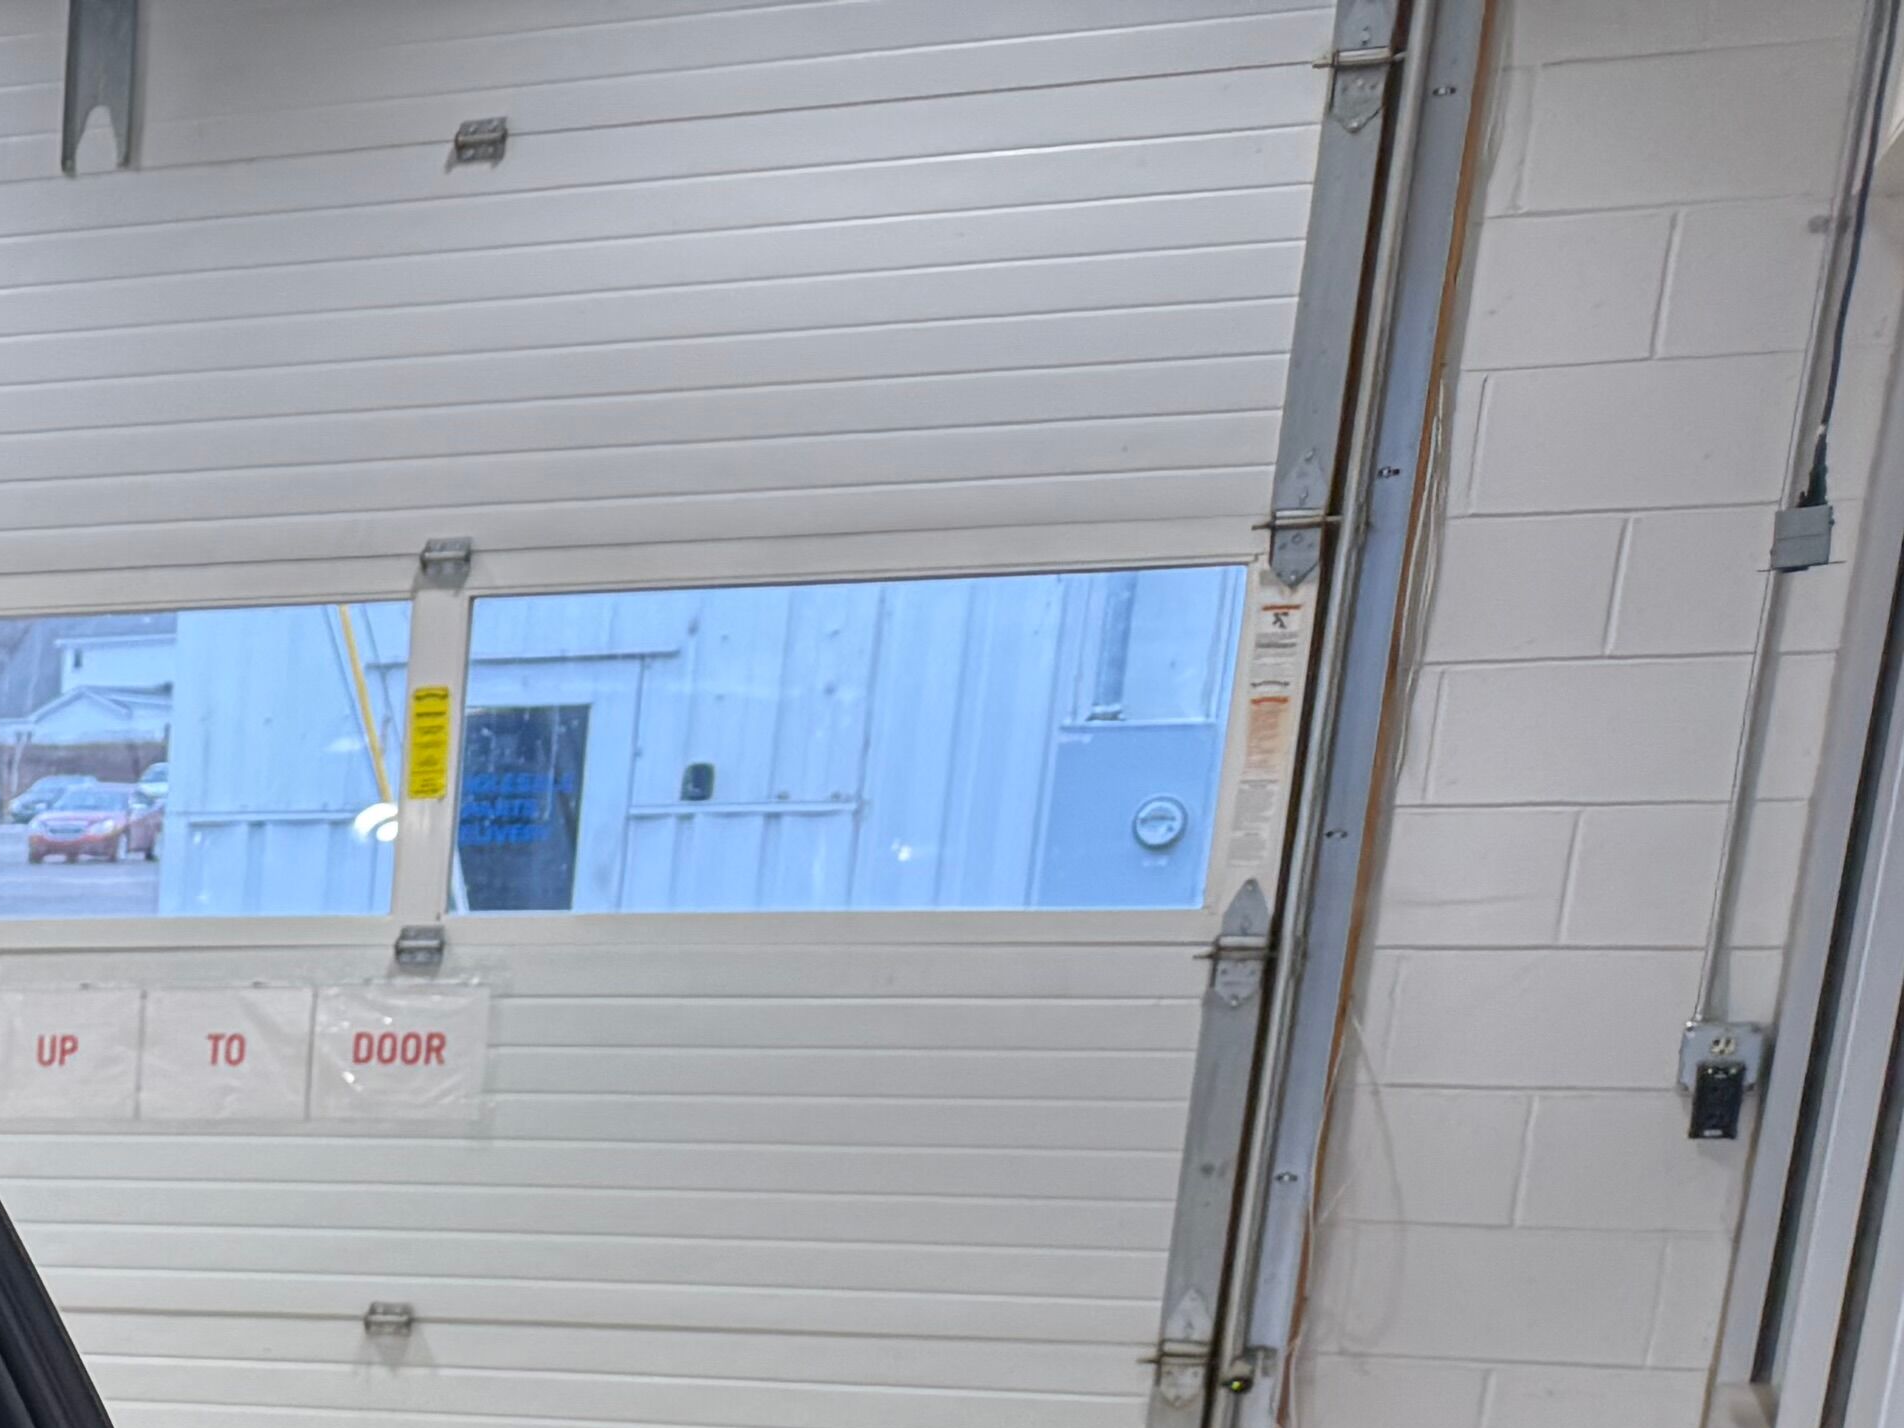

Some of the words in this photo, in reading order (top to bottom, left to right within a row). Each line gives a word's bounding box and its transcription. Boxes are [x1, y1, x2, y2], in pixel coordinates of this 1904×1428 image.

[36, 1033, 79, 1067] UP
[207, 1033, 246, 1067] TO
[352, 1030, 446, 1066] DOOR
